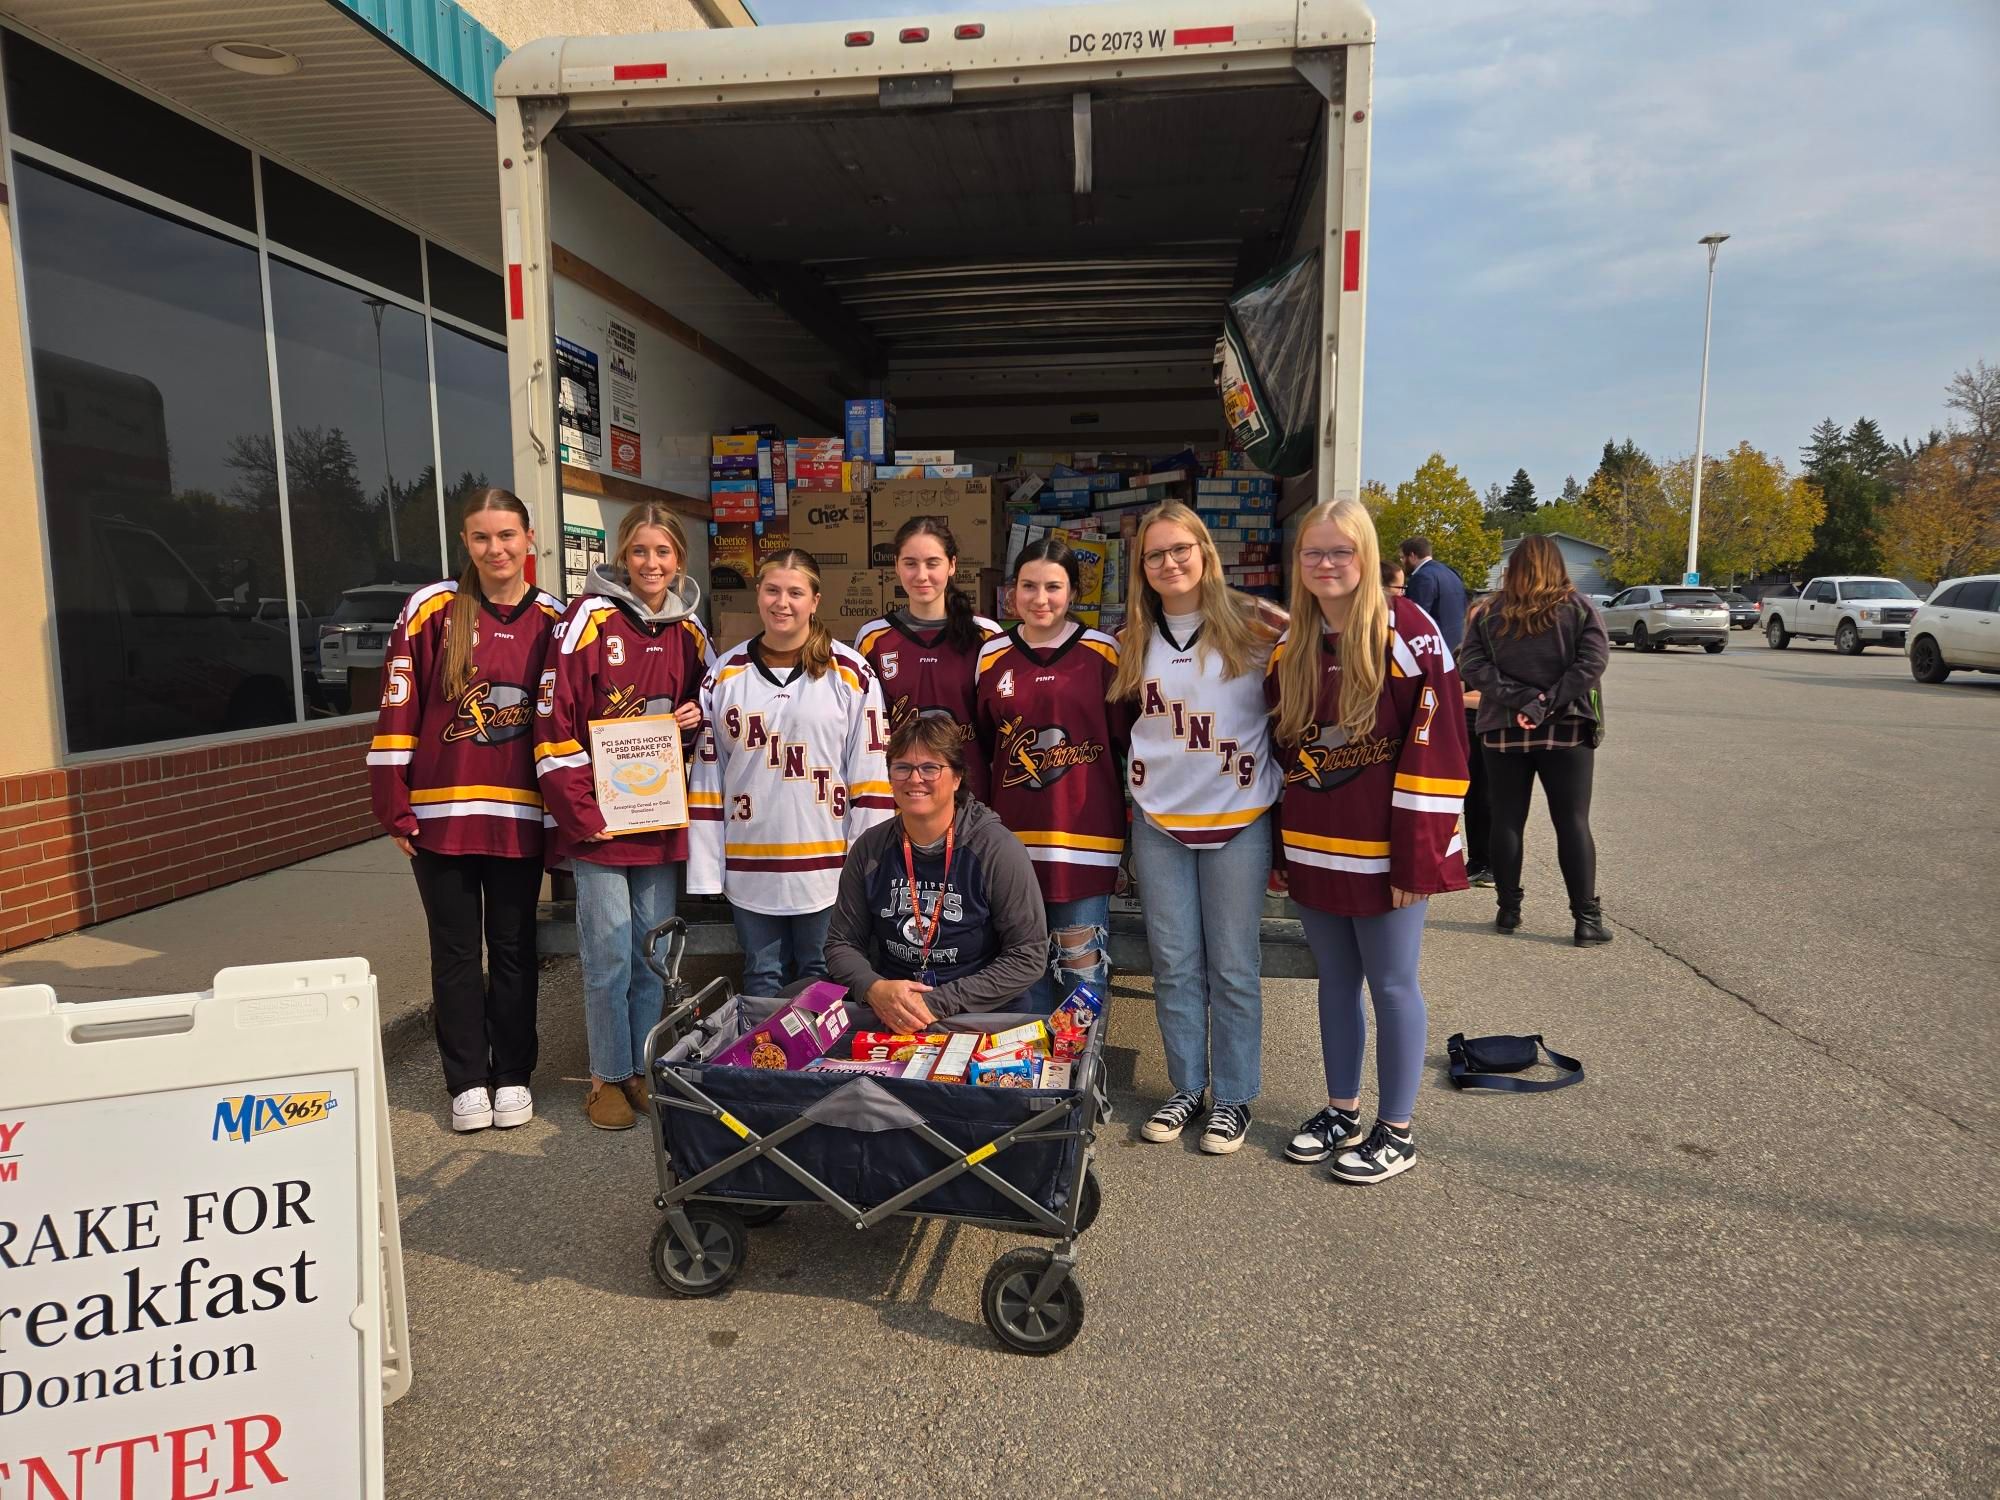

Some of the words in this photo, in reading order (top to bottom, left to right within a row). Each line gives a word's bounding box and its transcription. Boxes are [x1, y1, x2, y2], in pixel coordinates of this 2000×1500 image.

[1069, 34, 1096, 52] DC
[1101, 31, 1143, 51] 2073
[1148, 29, 1166, 48] W
[808, 507, 850, 525] Chex
[714, 535, 747, 546] Cheerios
[759, 538, 790, 548] Cheerio
[840, 605, 878, 617] Cheerios
[606, 635, 626, 666] 3
[880, 650, 899, 681] 5
[996, 668, 1015, 698] 4
[614, 738, 642, 746] SAINTS
[642, 735, 673, 744] HOCKEY
[630, 744, 655, 752] BRAKE
[1143, 677, 1257, 790] AINTS
[616, 750, 660, 760] BREAKFAST
[725, 703, 847, 820] SAINTS
[881, 886, 963, 922] JETS
[211, 1094, 292, 1145] MIX
[183, 1179, 316, 1244] FOR
[0, 1342, 258, 1417] Donation
[0, 1413, 289, 1500] NTER
